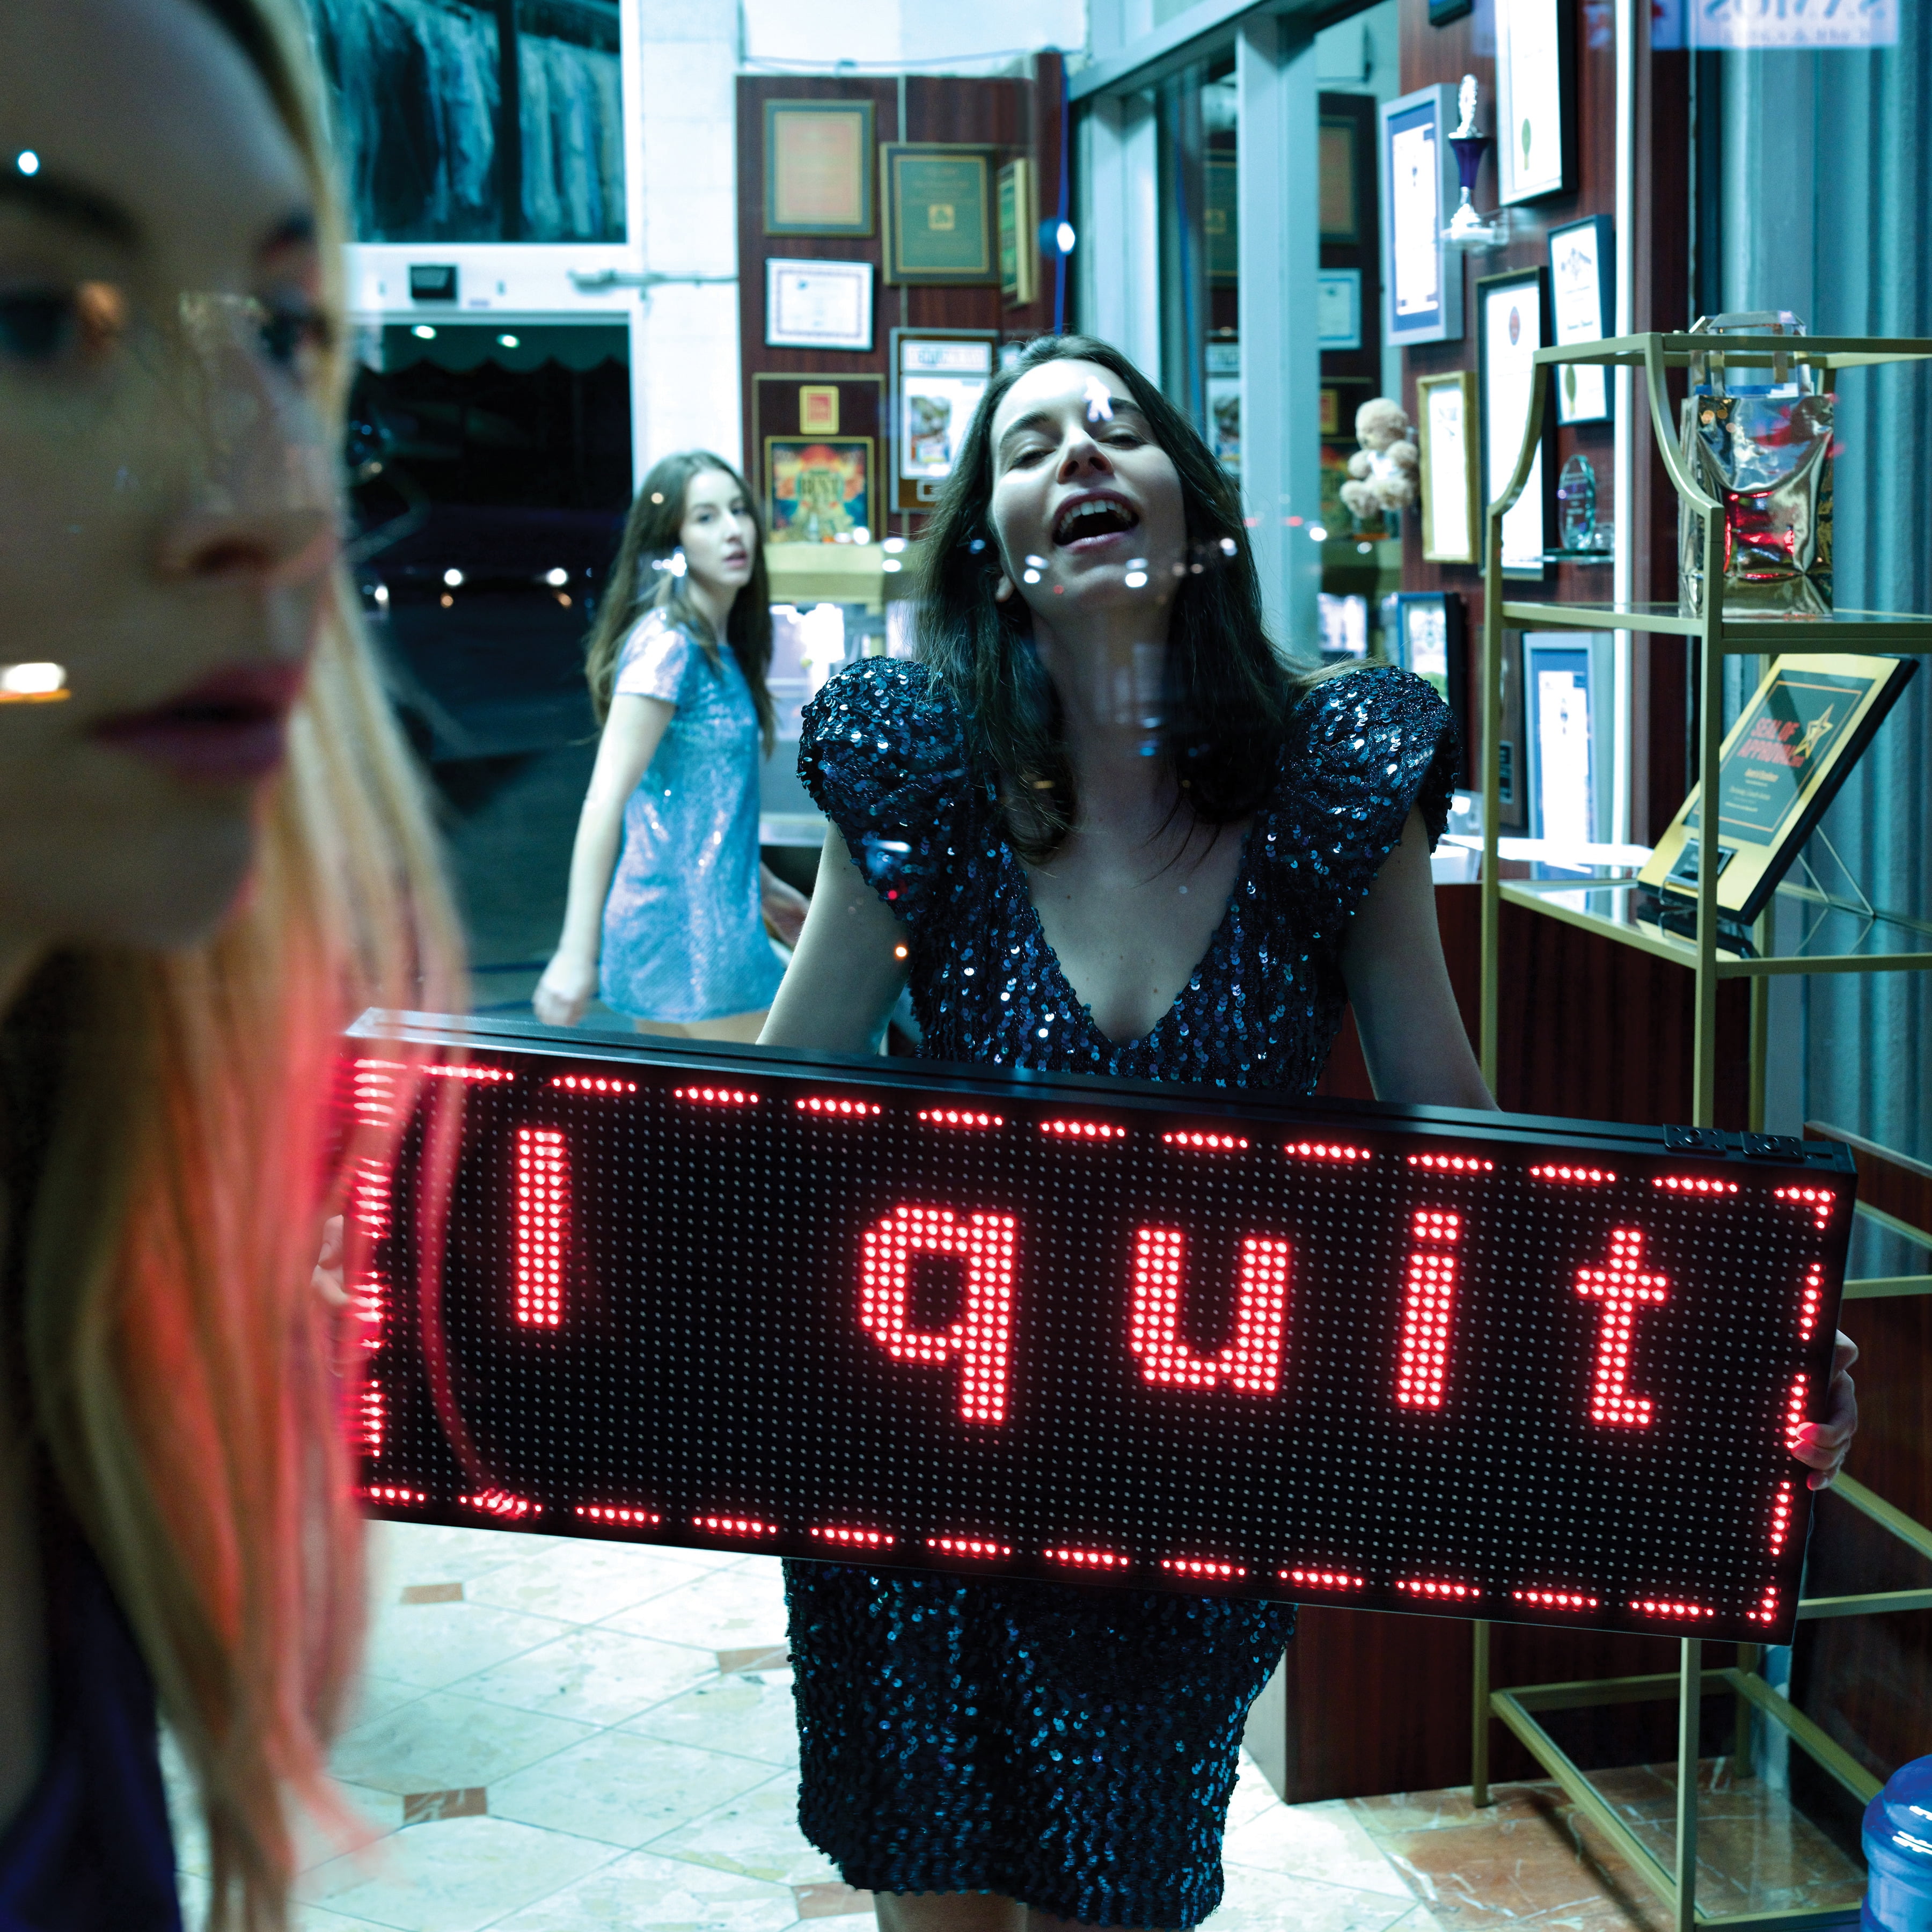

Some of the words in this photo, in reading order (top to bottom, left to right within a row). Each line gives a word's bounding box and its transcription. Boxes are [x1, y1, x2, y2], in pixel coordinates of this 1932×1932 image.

[1751, 717, 1783, 740] SEAL
[1777, 721, 1801, 742] OF
[515, 1128, 569, 1328] I
[860, 1204, 1670, 1425] quit
